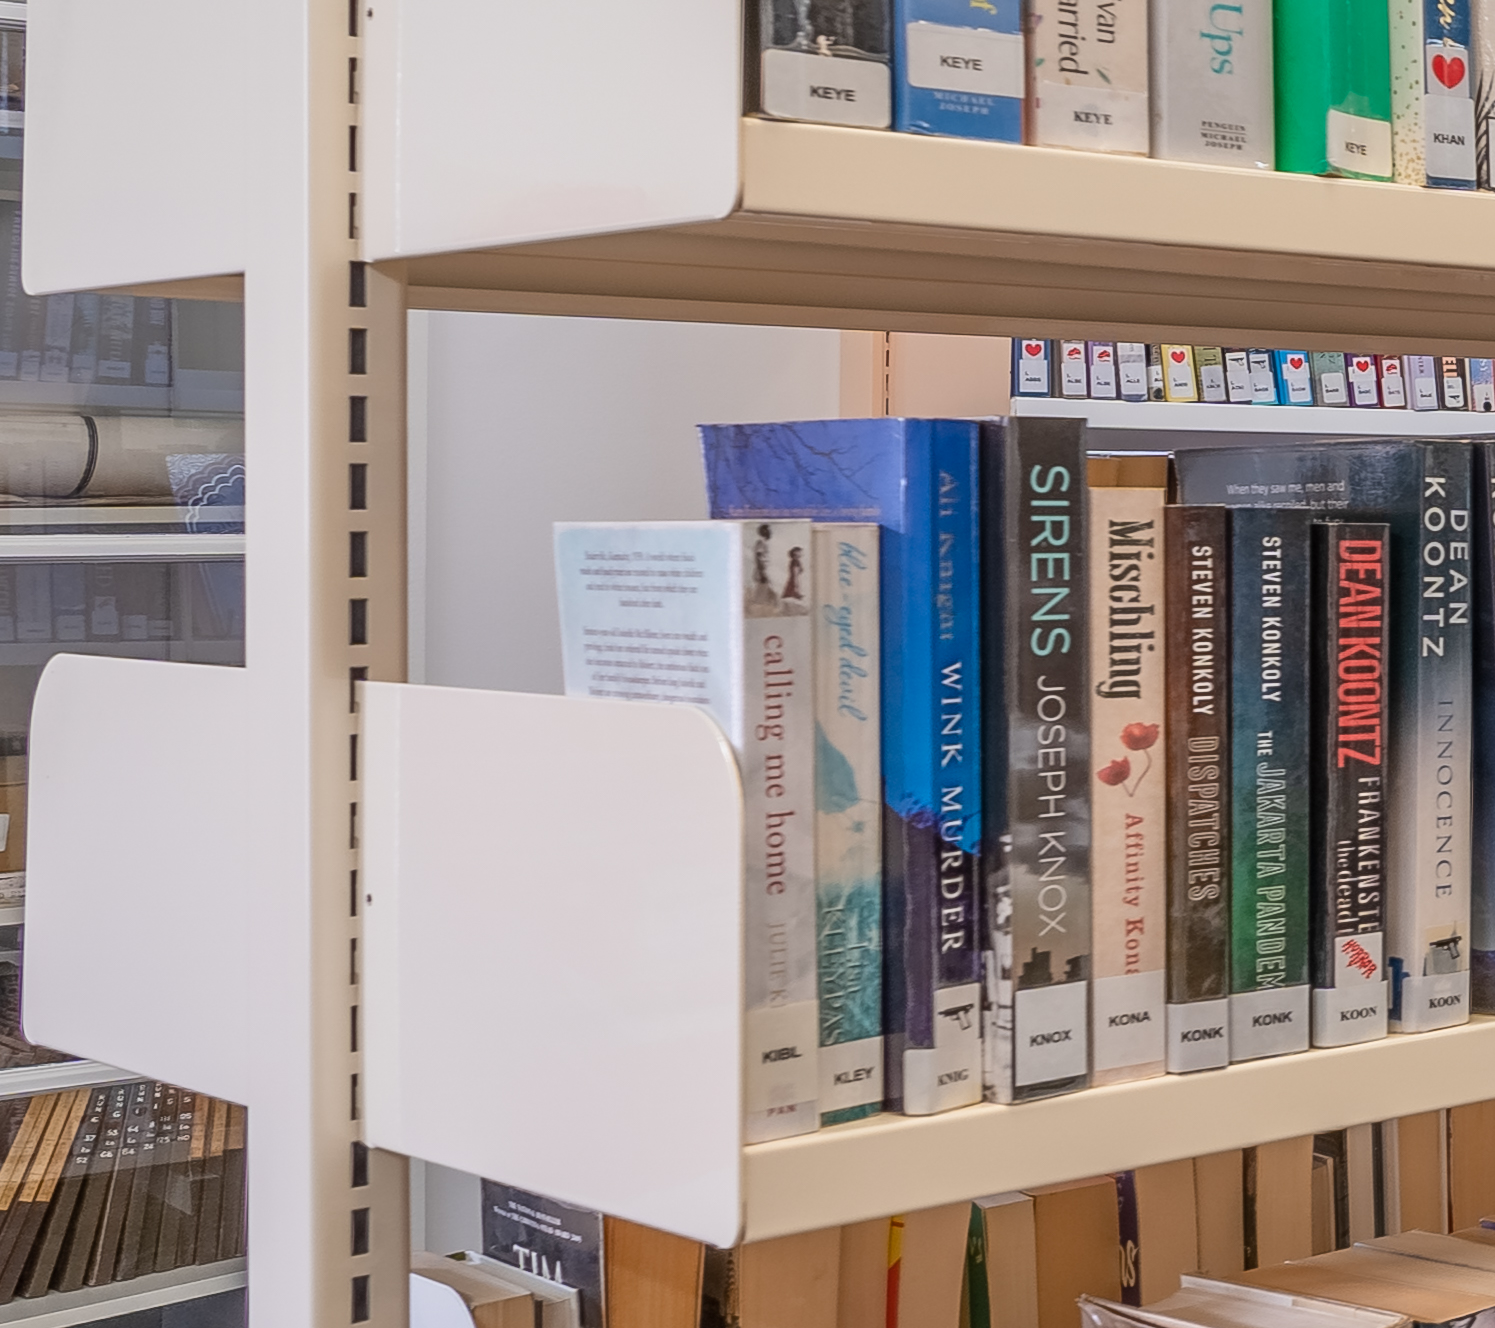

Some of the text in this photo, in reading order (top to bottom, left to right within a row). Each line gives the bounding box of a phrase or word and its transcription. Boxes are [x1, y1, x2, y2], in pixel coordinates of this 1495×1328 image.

[808, 83, 857, 104] KEYE
[1207, 1, 1245, 76] Ups
[1030, 464, 1072, 937] SIRENS JOSEPH KNOX
[1096, 520, 1159, 700] Mischling
[1261, 536, 1282, 703] STEVEN KONKOLY
[1337, 540, 1382, 768] DEAN KOONTZ
[757, 635, 795, 897] calling me home
[940, 662, 964, 954] WINK MURDER
[1435, 697, 1453, 900] INNOCENCE
